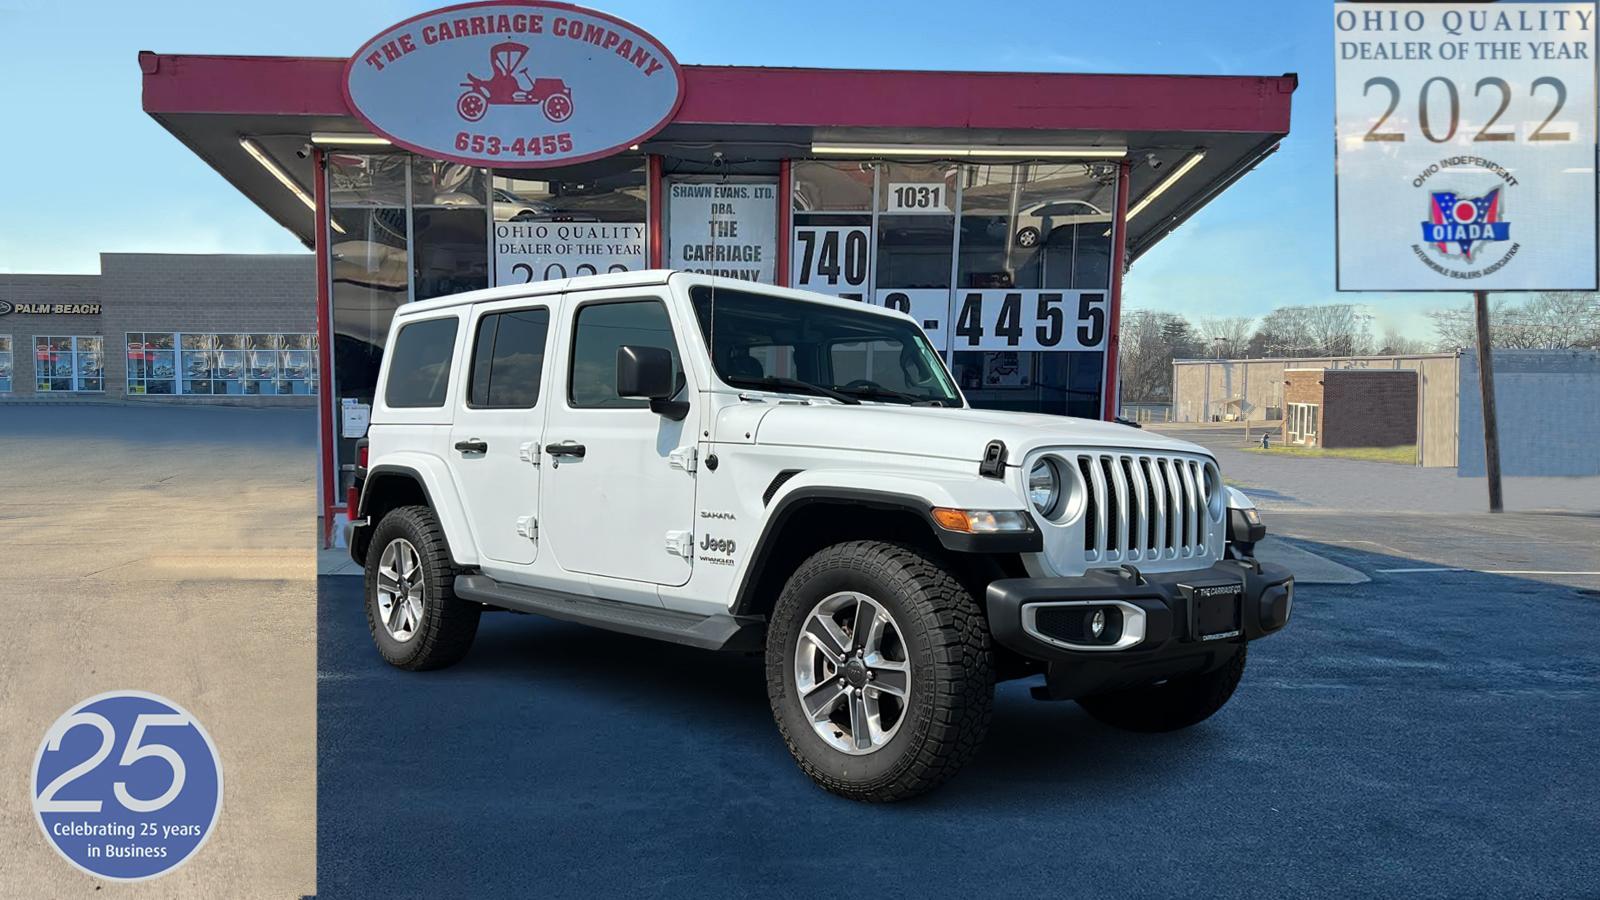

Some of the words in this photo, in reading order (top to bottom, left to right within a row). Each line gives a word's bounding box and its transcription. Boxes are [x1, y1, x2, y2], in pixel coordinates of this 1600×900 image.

[1336, 10, 1426, 31] OHIO
[1441, 10, 1593, 35] QUALITY
[366, 33, 417, 72] THE
[422, 14, 544, 45] CARRIAGE
[552, 17, 664, 77] COMPANY
[1340, 42, 1433, 60] DEALER
[1438, 42, 1469, 60] OF
[1475, 42, 1522, 60] THE
[1527, 42, 1589, 60] YEAR
[1362, 76, 1571, 143] 2022
[454, 132, 573, 157] 653-4455
[1412, 163, 1440, 188] OHIO
[1440, 156, 1519, 188] INDEPENDENT
[672, 186, 713, 199] SHAWN
[754, 187, 775, 199] LTD.
[894, 186, 940, 208] 1031
[711, 203, 736, 216] DBA.
[497, 225, 549, 239] OHIO
[558, 225, 644, 241] QUALITY
[708, 220, 738, 238] THE
[1432, 224, 1495, 240] OIADA
[499, 243, 552, 255] DEALER
[555, 243, 573, 255] OF
[575, 244, 602, 255] THE
[605, 244, 641, 255] YEAR
[683, 244, 762, 262] CARRIAGE
[796, 229, 868, 286] 740
[1411, 244, 1449, 277] AUTOMOBILE
[1449, 270, 1482, 280] DEALERS
[1482, 242, 1521, 276] ASSOCIATION
[683, 268, 761, 283] PANY
[15, 303, 51, 314] PALM
[54, 304, 100, 315] BEACH
[701, 512, 736, 520] SAHARA
[700, 533, 737, 556] Jeep
